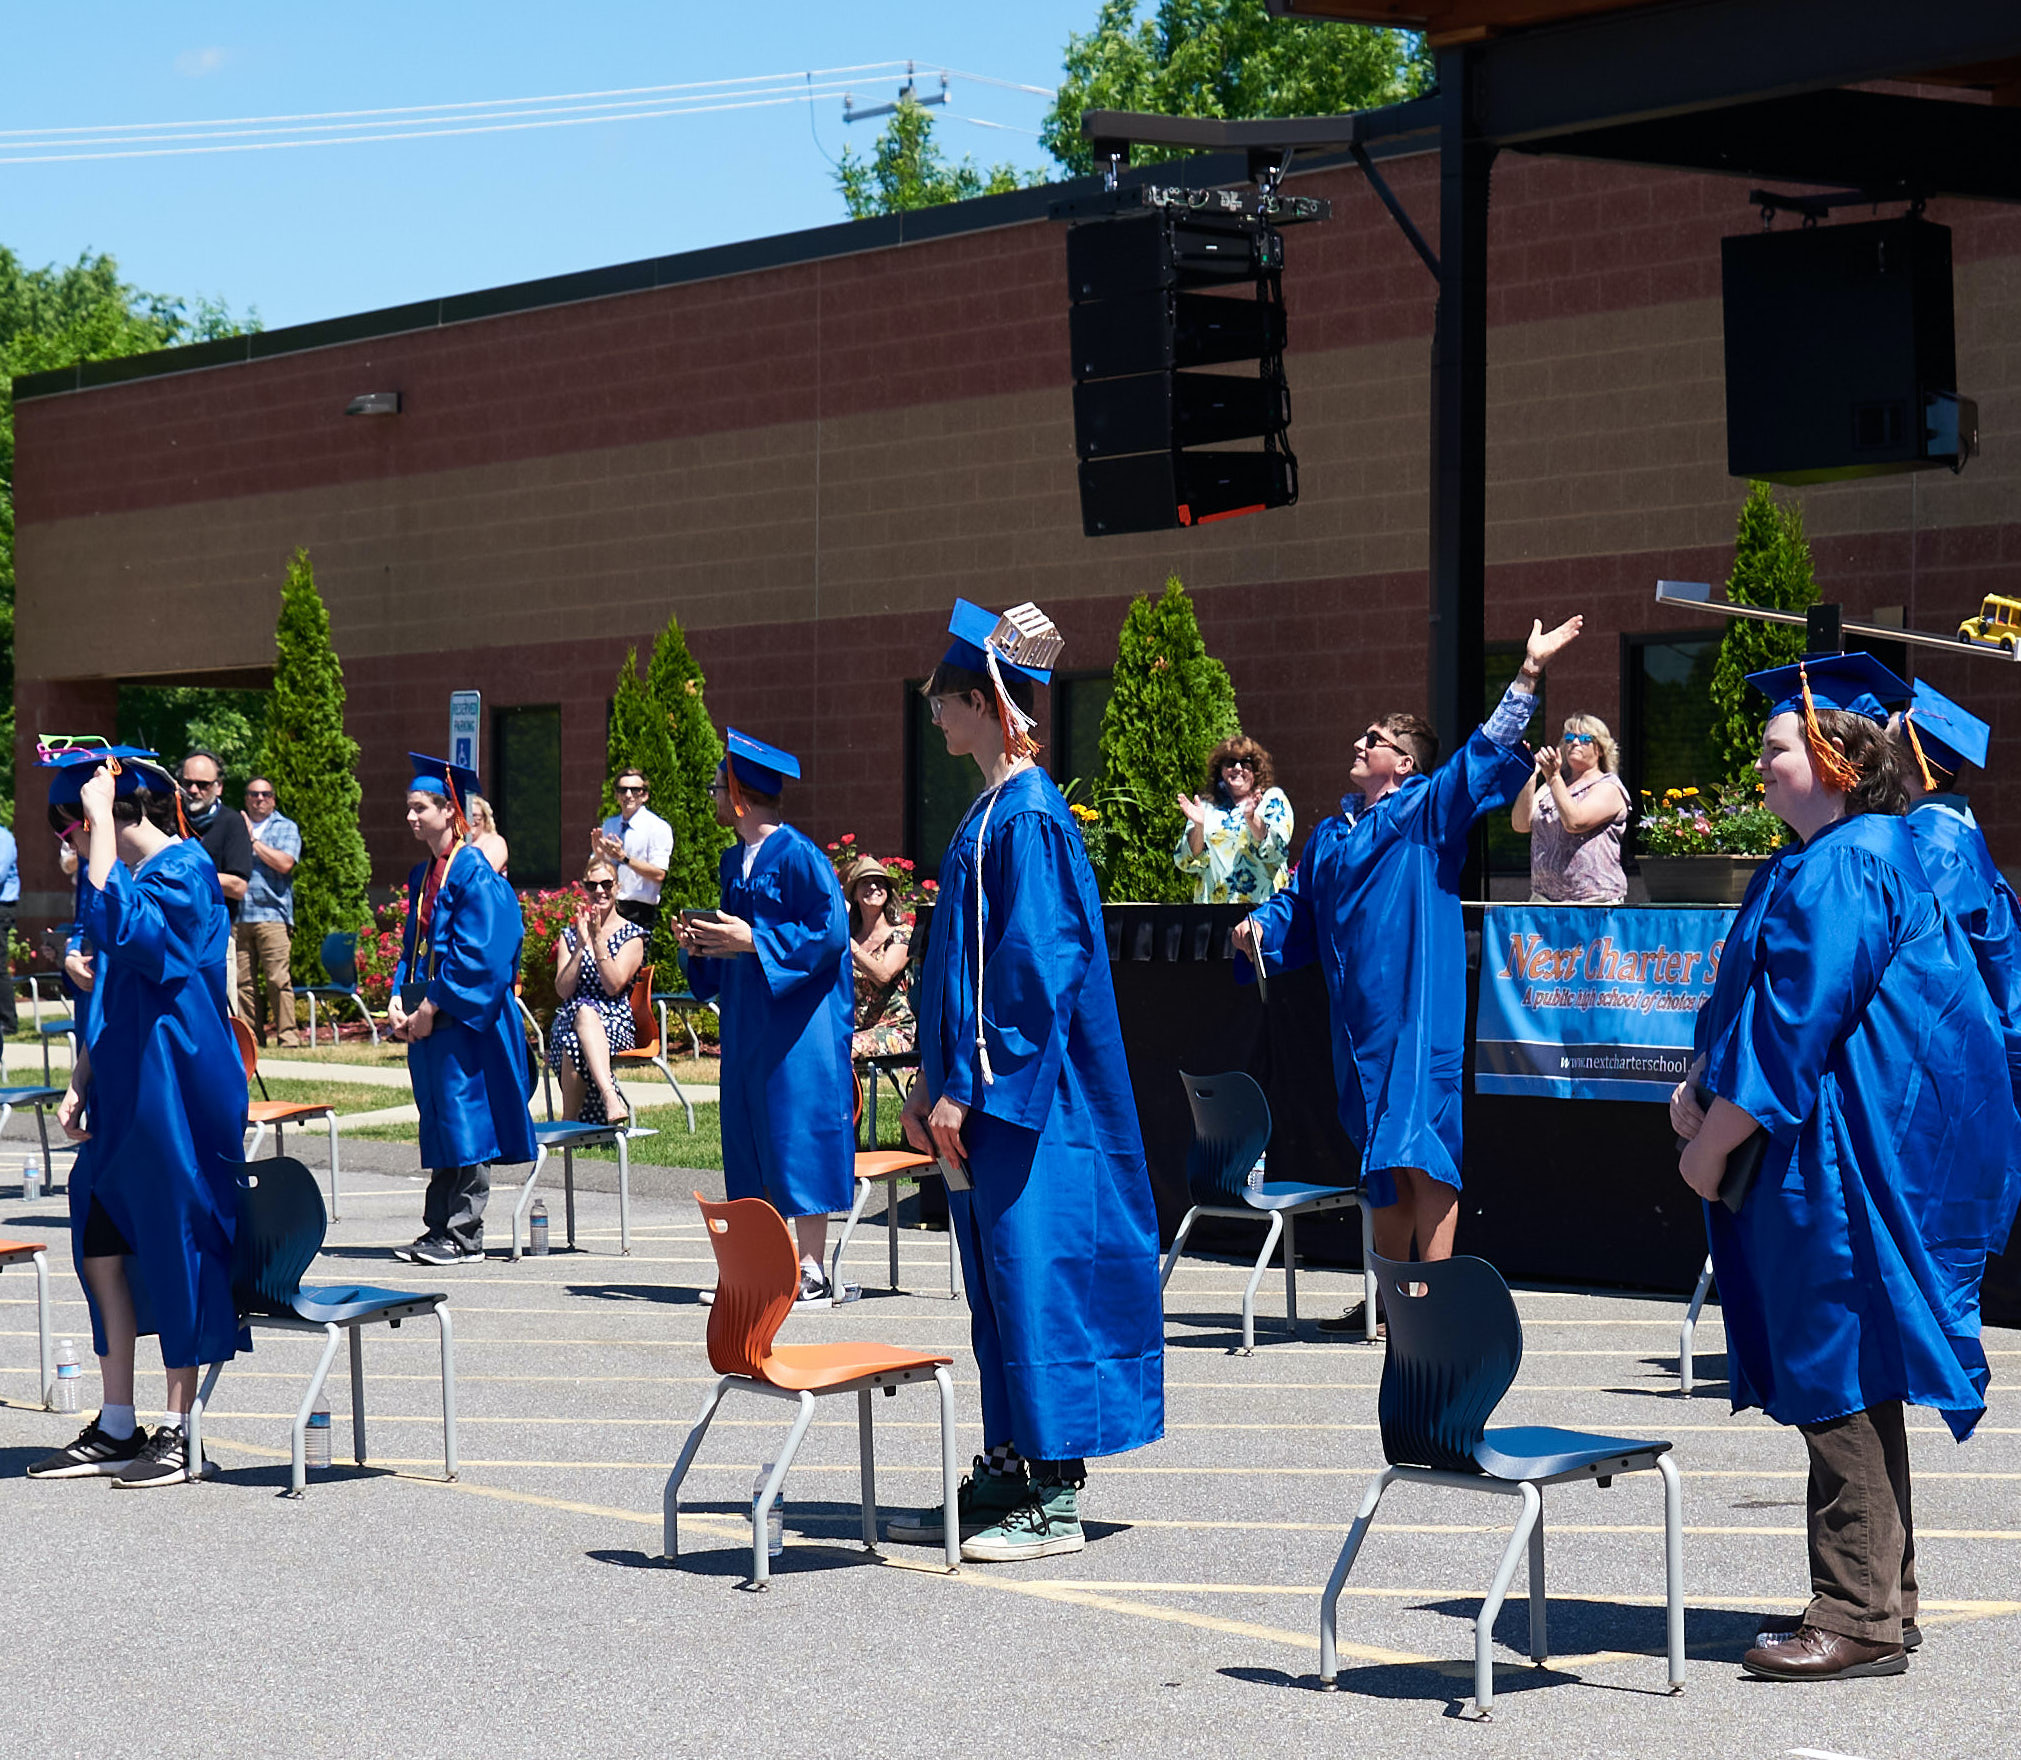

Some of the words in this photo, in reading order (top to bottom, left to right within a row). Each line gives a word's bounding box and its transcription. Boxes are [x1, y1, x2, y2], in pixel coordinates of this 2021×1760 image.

[1499, 933, 1583, 981] Next
[1584, 936, 1701, 984] Charter
[1521, 986, 1533, 1007] A
[1532, 986, 1576, 1011] public
[1597, 987, 1643, 1009] school
[1641, 990, 1660, 1014] of
[1656, 989, 1696, 1012] choice
